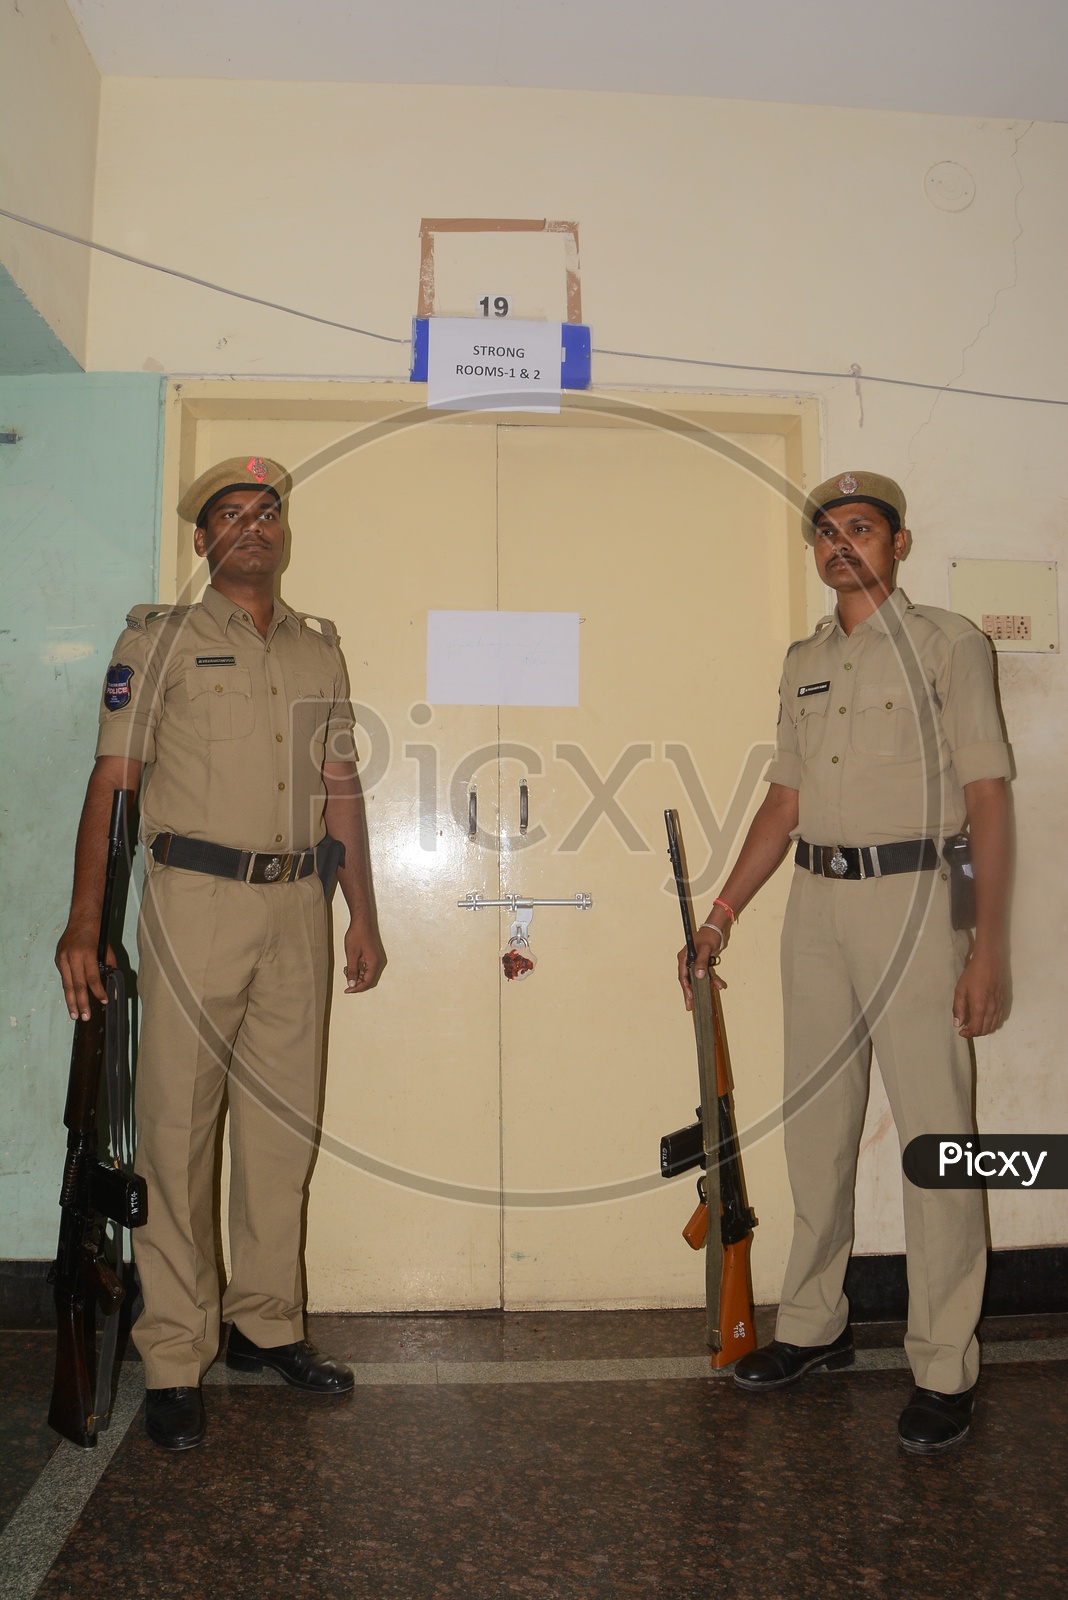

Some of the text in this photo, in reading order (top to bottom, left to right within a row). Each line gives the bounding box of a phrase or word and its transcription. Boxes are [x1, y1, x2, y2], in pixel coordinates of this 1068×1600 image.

[479, 296, 509, 317] 19
[473, 345, 525, 359] STRONG
[456, 364, 541, 380] ROOMS-1 & 2
[106, 686, 128, 695] POLICE
